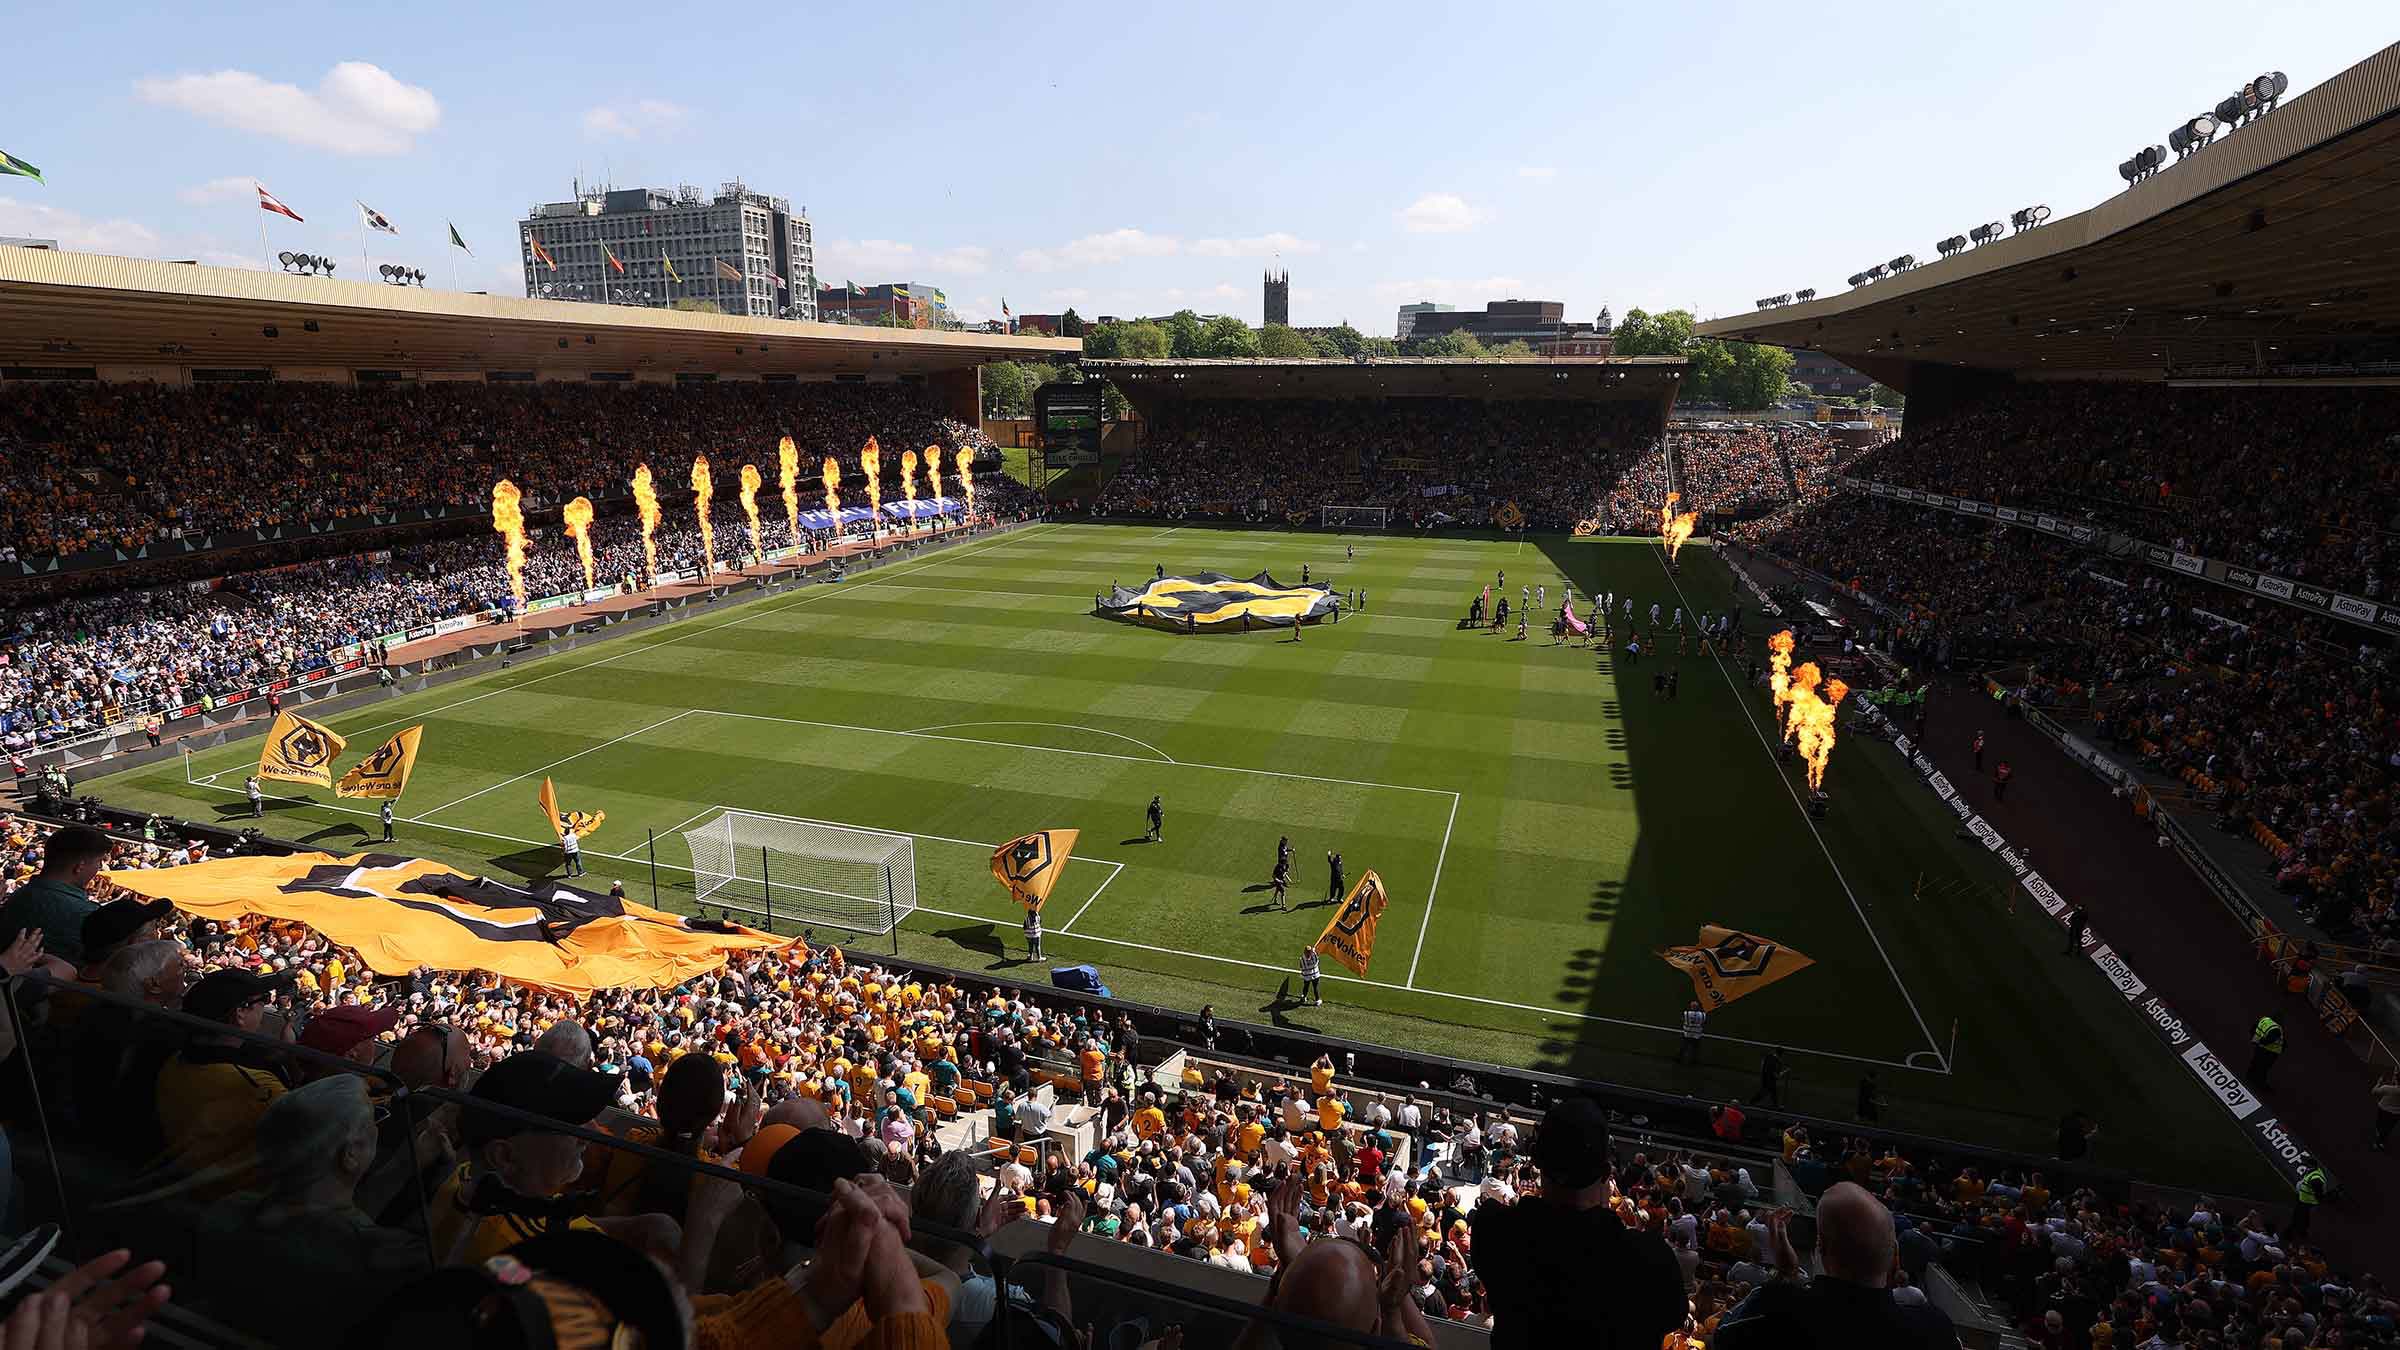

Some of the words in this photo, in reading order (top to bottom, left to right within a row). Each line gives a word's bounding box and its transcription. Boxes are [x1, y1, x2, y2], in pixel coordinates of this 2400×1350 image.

[2260, 577, 2290, 595] AstroPay
[2295, 586, 2328, 606] AstroPay
[2335, 597, 2371, 617] AstroPay
[408, 626, 434, 640] AstroPay
[334, 659, 362, 674] 12BET
[297, 670, 328, 684] 12BET
[214, 691, 250, 708] 12BET
[168, 705, 202, 721] 12BE
[263, 764, 280, 775] We
[1971, 820, 1999, 846] AstroPay
[2000, 846, 2029, 876] AstroPay
[2028, 877, 2060, 909] AstroPay
[2060, 911, 2097, 948] APay
[2099, 952, 2138, 992] AstroPay
[2141, 997, 2191, 1045] AstroPay
[2193, 1052, 2249, 1107] AstroPay
[1143, 1119, 1151, 1131] 2
[2255, 1117, 2312, 1175] AstroPa
